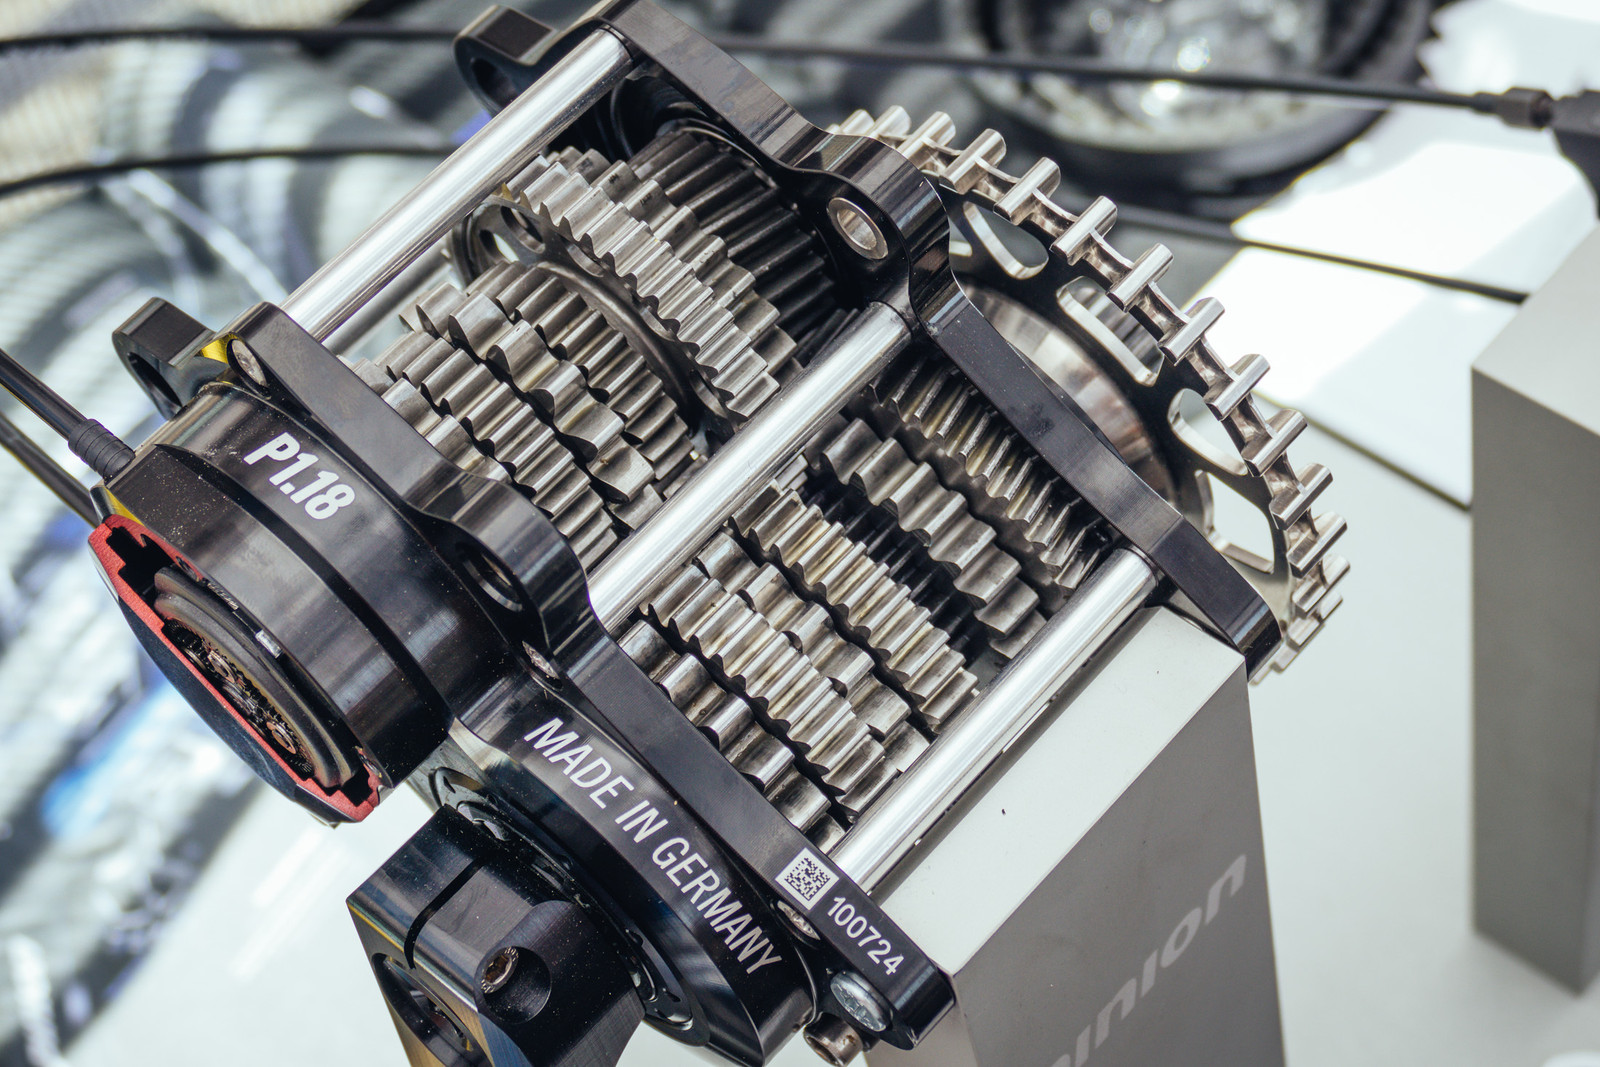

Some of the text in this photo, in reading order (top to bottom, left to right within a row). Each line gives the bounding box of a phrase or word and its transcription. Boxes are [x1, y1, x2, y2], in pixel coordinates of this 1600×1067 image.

[243, 431, 356, 520] P1.18
[523, 717, 783, 975] MADE IN GERMANY
[827, 896, 905, 976] 100724
[1051, 853, 1248, 1067] inion
